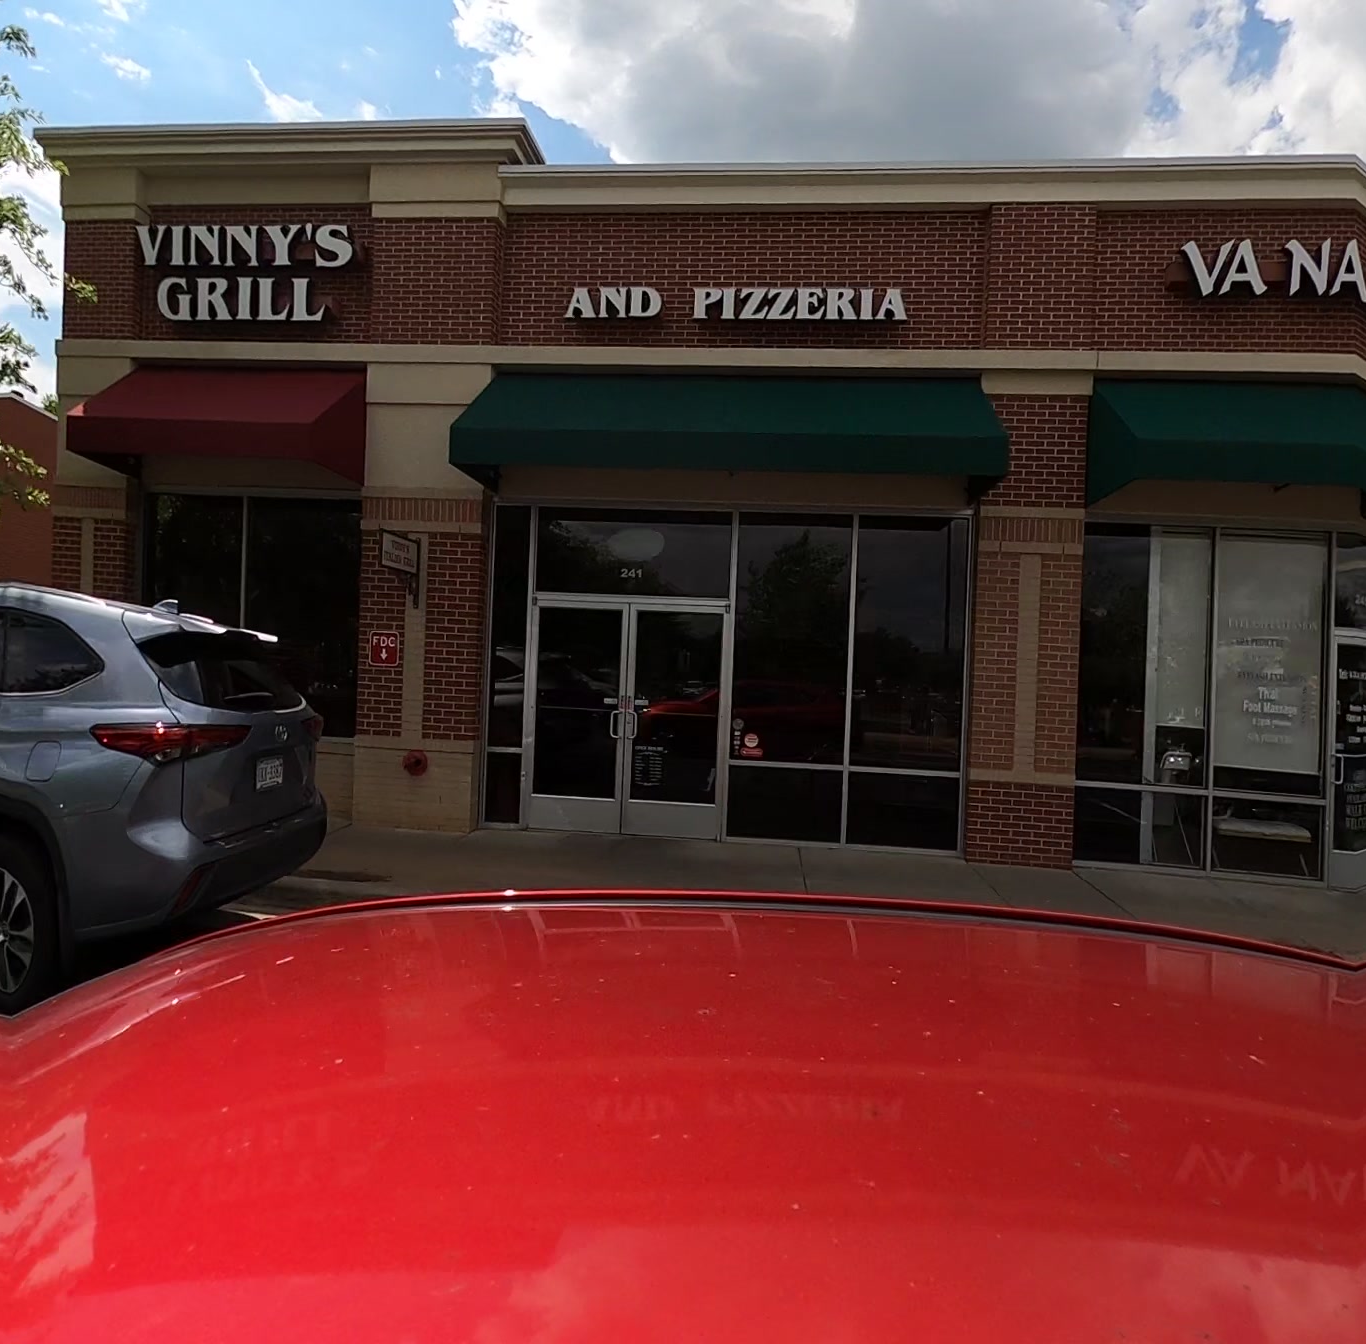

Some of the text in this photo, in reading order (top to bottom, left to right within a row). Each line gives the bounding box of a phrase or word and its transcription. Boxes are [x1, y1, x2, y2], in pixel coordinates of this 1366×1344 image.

[136, 223, 356, 268] VINNY'S
[1181, 238, 1268, 298] VA
[157, 276, 327, 322] GRILL
[564, 286, 908, 320] AND PIZZERIA
[620, 567, 643, 579] 241
[372, 636, 397, 647] FDC
[1243, 699, 1262, 713] Foot
